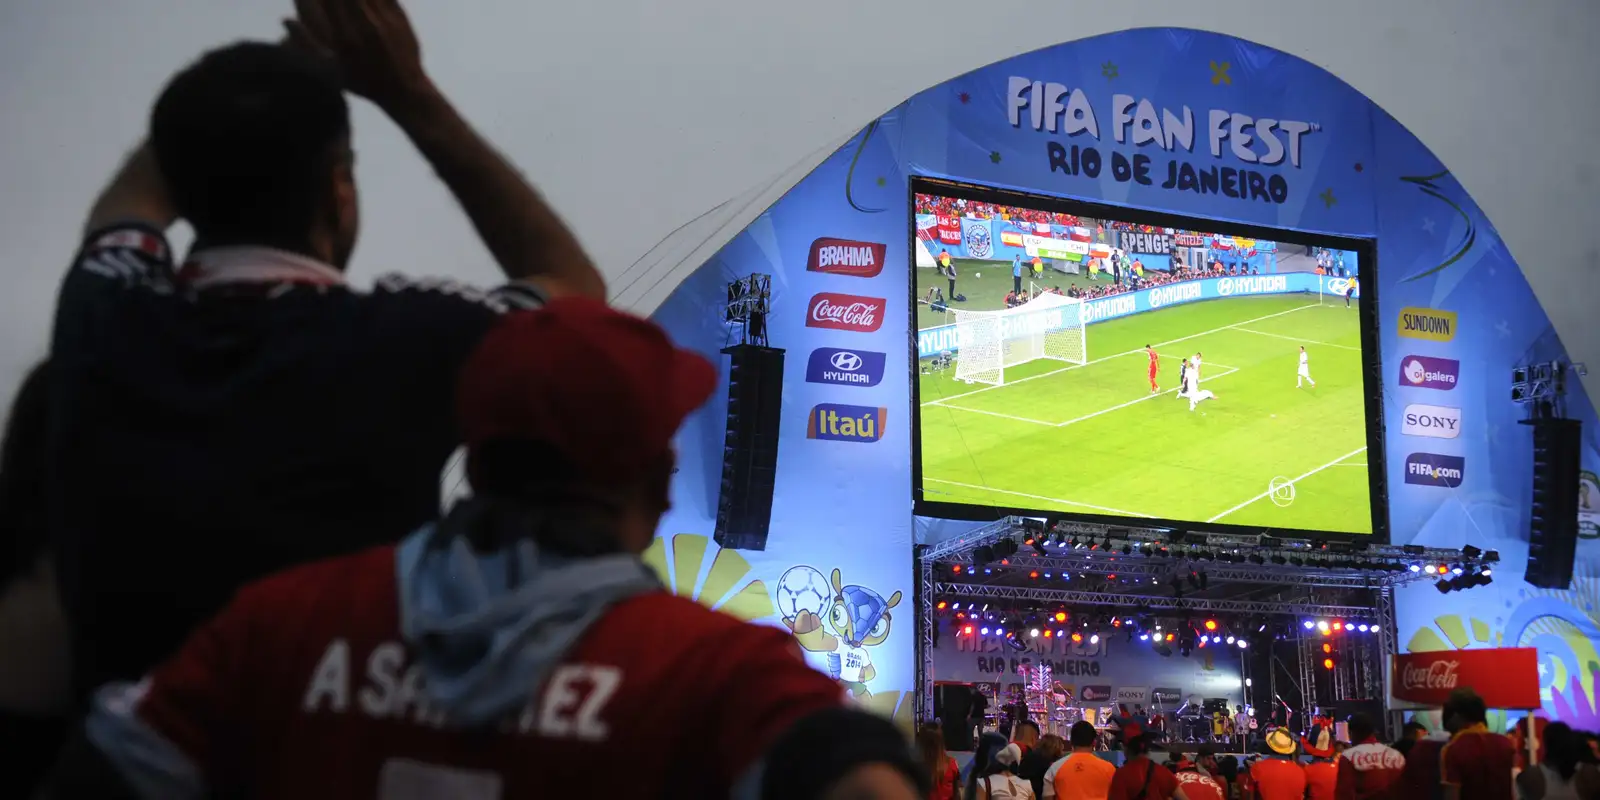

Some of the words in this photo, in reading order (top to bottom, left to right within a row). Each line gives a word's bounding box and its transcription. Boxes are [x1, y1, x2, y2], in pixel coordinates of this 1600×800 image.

[1008, 76, 1100, 141] FIFA
[1112, 94, 1195, 152] FAN
[1209, 109, 1310, 168] FEST
[1047, 141, 1102, 179] RIO
[1111, 151, 1153, 185] DE
[1162, 160, 1288, 204] JANEIRO
[1121, 232, 1169, 253] SPENGE
[819, 245, 874, 267] BRAHMA
[1161, 282, 1200, 305] HYUNDAI
[1235, 276, 1286, 293] HYUNDAI
[813, 299, 878, 326] Coca-Cola
[1094, 293, 1135, 318] HYUNDAI
[1403, 313, 1450, 335] SUNDOWN
[823, 371, 869, 384] HYUNDAI
[1425, 370, 1455, 384] galera
[819, 409, 874, 438] Itaú
[1406, 413, 1458, 430] SONY
[1408, 462, 1461, 479] FIFA.com
[977, 656, 1005, 673] RIO
[358, 643, 624, 741] SAEZ
[1118, 691, 1145, 699] SONY
